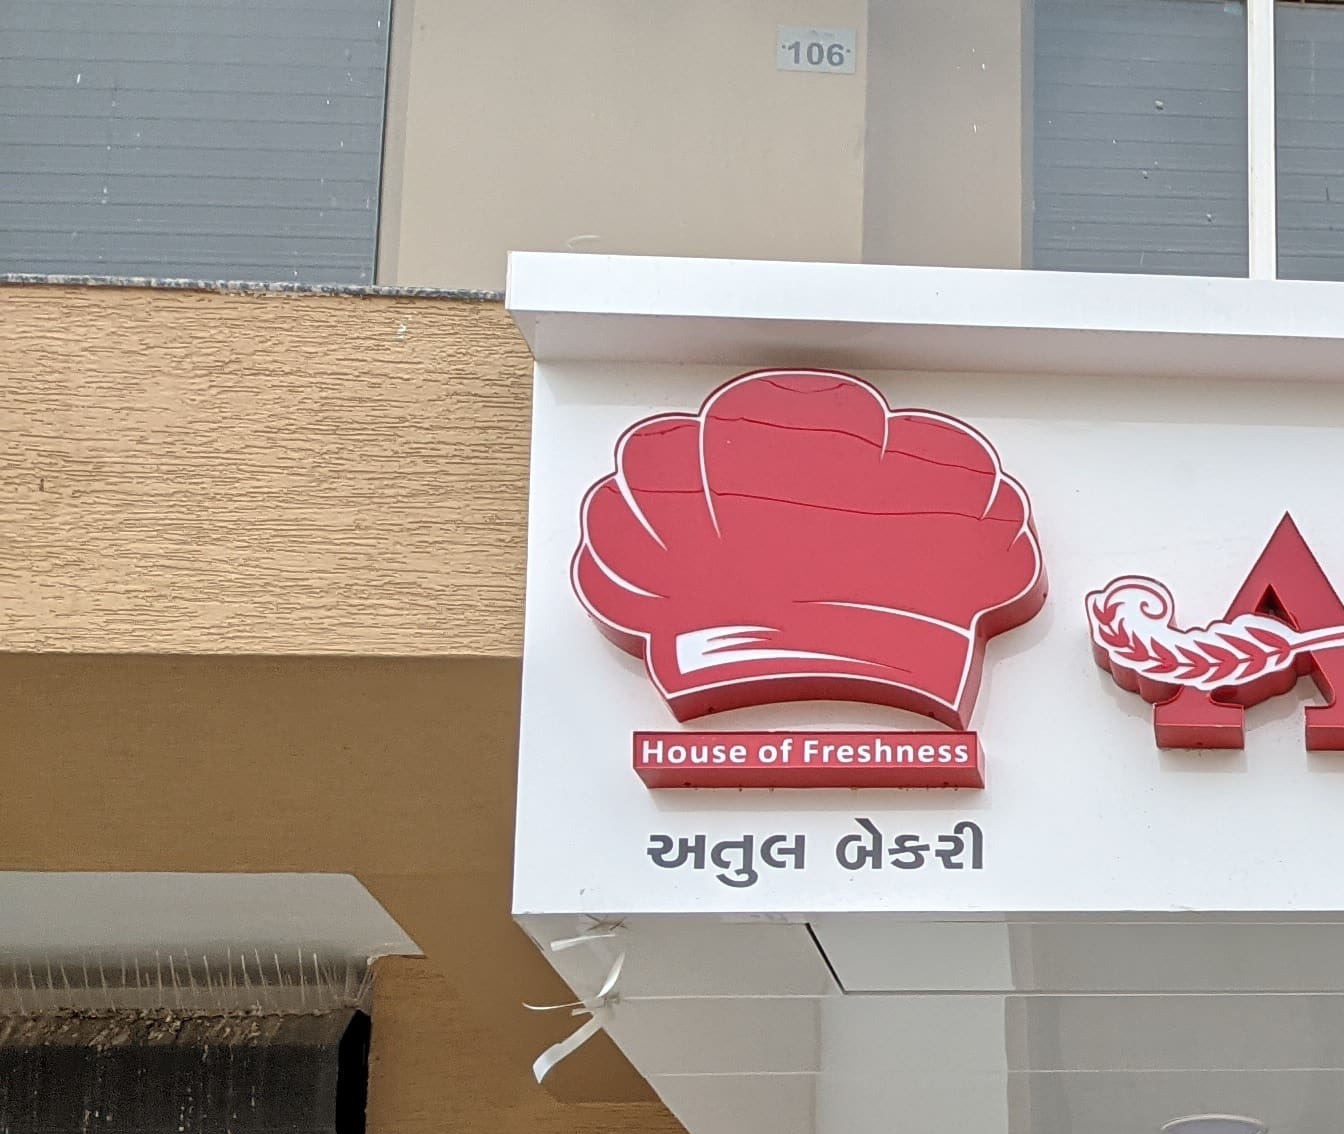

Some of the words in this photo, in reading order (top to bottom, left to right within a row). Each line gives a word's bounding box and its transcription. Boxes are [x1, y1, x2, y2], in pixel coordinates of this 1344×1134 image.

[787, 41, 845, 67] 106
[641, 739, 748, 764] House
[758, 738, 794, 763] of
[802, 738, 970, 763] Freshness
[646, 834, 807, 888] અતુલ
[835, 816, 985, 871] બેકરી
